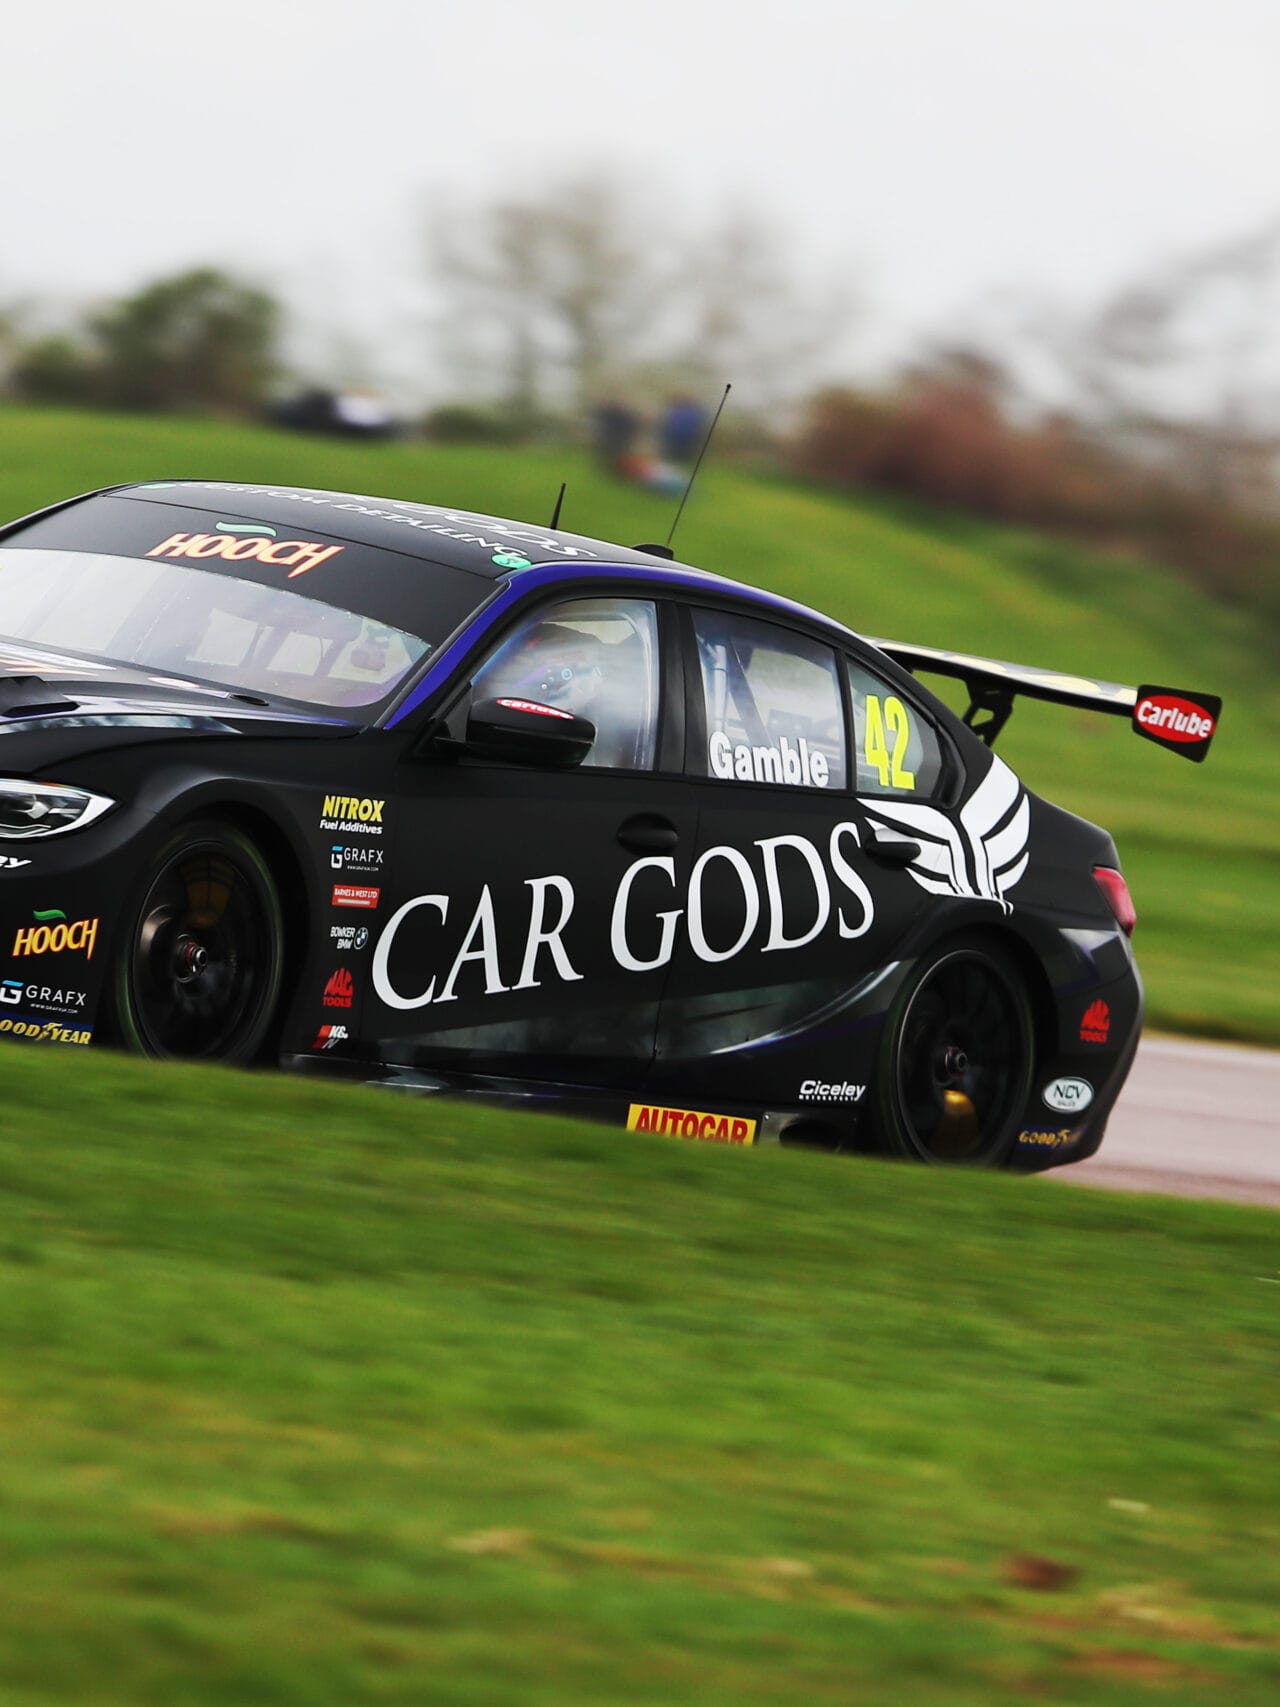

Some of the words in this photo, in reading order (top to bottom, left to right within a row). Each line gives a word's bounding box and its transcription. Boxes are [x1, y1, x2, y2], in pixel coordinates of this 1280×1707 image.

[331, 503, 528, 557] DETAILING
[144, 532, 346, 578] HOOCH
[1137, 700, 1213, 738] Carlube
[864, 694, 915, 791] 42
[709, 730, 830, 788] Gamble
[322, 795, 385, 822] NITROX
[319, 819, 339, 830] Fuel
[339, 821, 383, 835] Additives
[343, 847, 384, 864] GRAFX
[371, 874, 584, 1010] CAR
[609, 821, 875, 972] GODS
[12, 918, 99, 961] HOOCH
[330, 926, 356, 938] BOWKER
[336, 938, 353, 949] BMW
[25, 984, 87, 1006] GRAFX
[323, 967, 353, 996] MAC
[322, 996, 353, 1008] TOOLS
[799, 1080, 866, 1101] Ciceley
[1054, 1084, 1084, 1099] NCV
[634, 1107, 748, 1145] AUTOCAR
